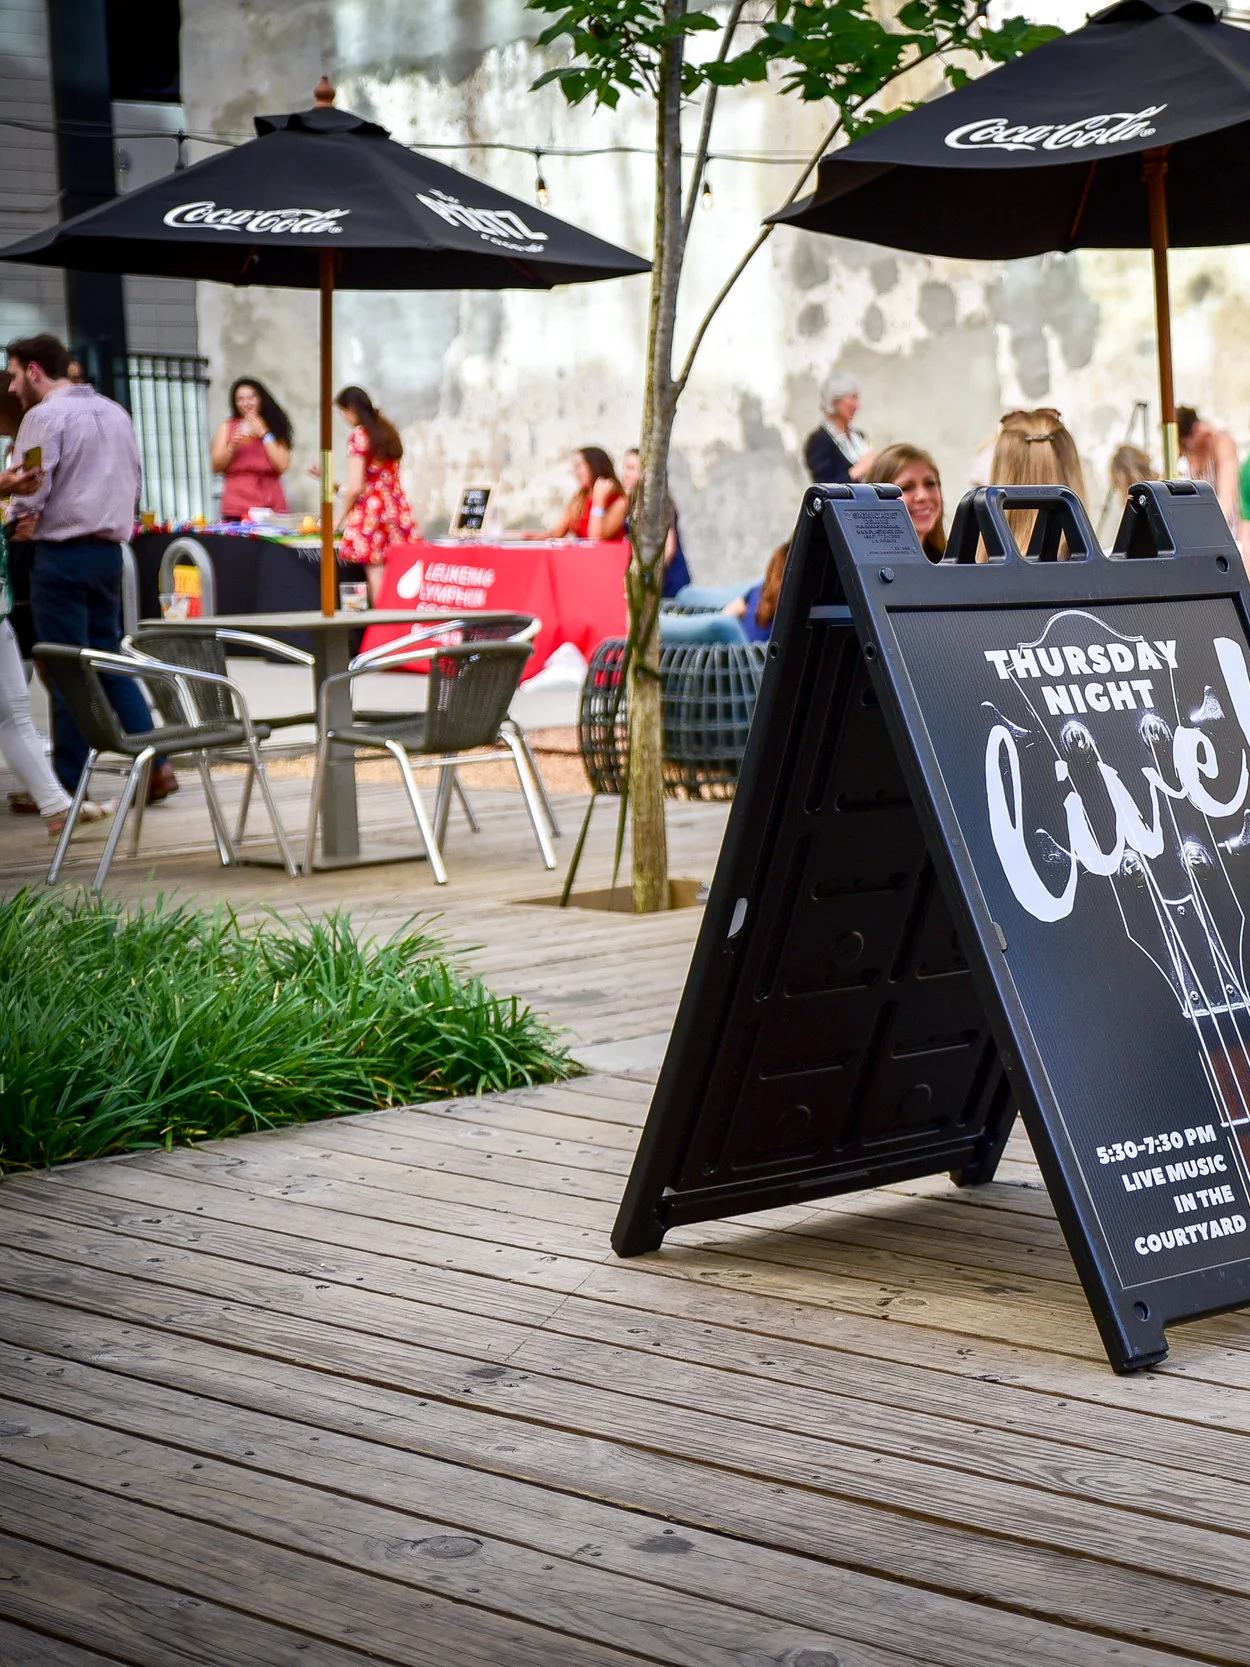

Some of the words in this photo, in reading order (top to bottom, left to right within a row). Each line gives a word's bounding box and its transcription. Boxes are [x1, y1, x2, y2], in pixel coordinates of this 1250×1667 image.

[944, 103, 1168, 151] Coca-Cola
[163, 200, 351, 234] Coca-Cola
[984, 640, 1178, 679] THURSDAY
[1041, 679, 1155, 715] NIGHT
[1096, 1131, 1185, 1165] 5:30-7:30
[1184, 1124, 1217, 1146] PM
[1121, 1167, 1167, 1192] LIVE
[1165, 1154, 1228, 1183] MUSIC
[1173, 1193, 1198, 1214] IN
[1196, 1184, 1236, 1208] THE
[1134, 1214, 1247, 1256] COURTYARD
